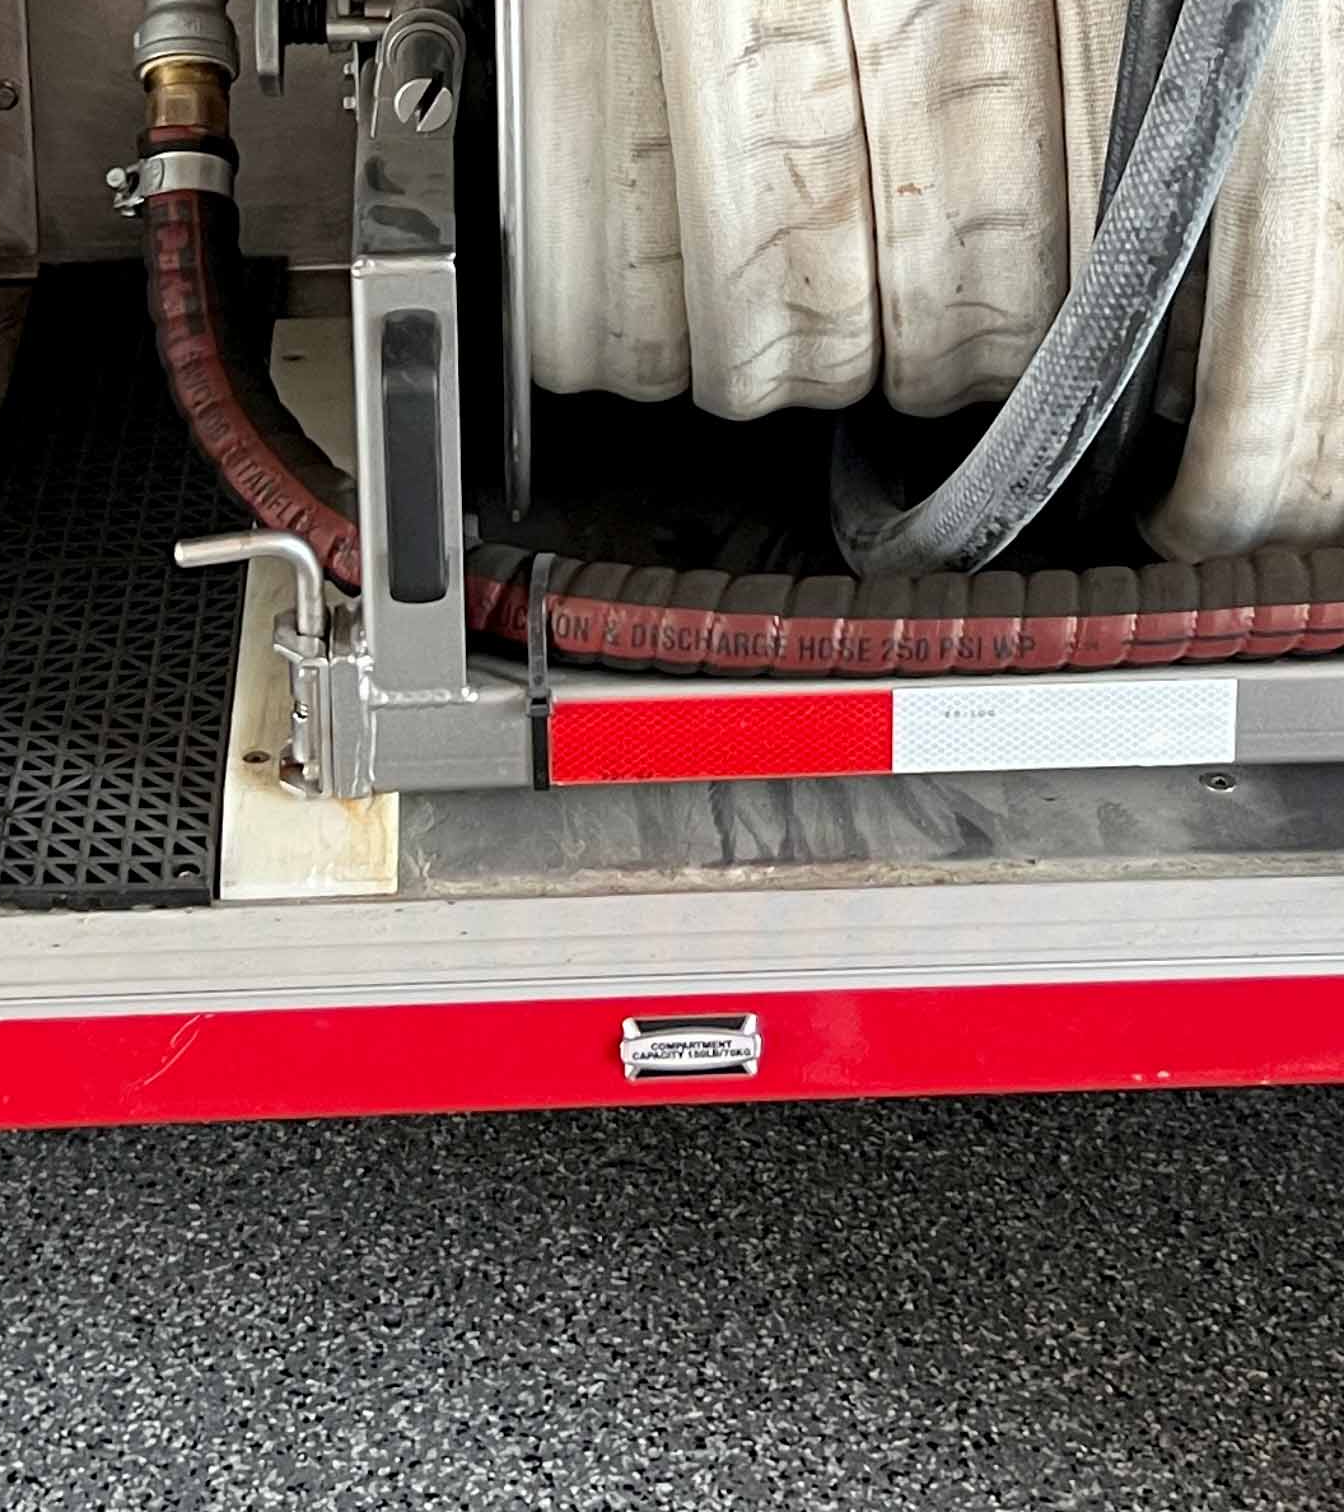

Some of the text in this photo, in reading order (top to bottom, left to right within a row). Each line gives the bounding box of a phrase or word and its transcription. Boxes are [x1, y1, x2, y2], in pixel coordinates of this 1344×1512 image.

[630, 622, 787, 660] DISCHARGE
[798, 636, 873, 664] HOSE
[880, 638, 929, 663] 250
[939, 636, 982, 661] PSI
[650, 1039, 733, 1051] COMPARTMENT
[632, 1049, 684, 1060] CAPACITY
